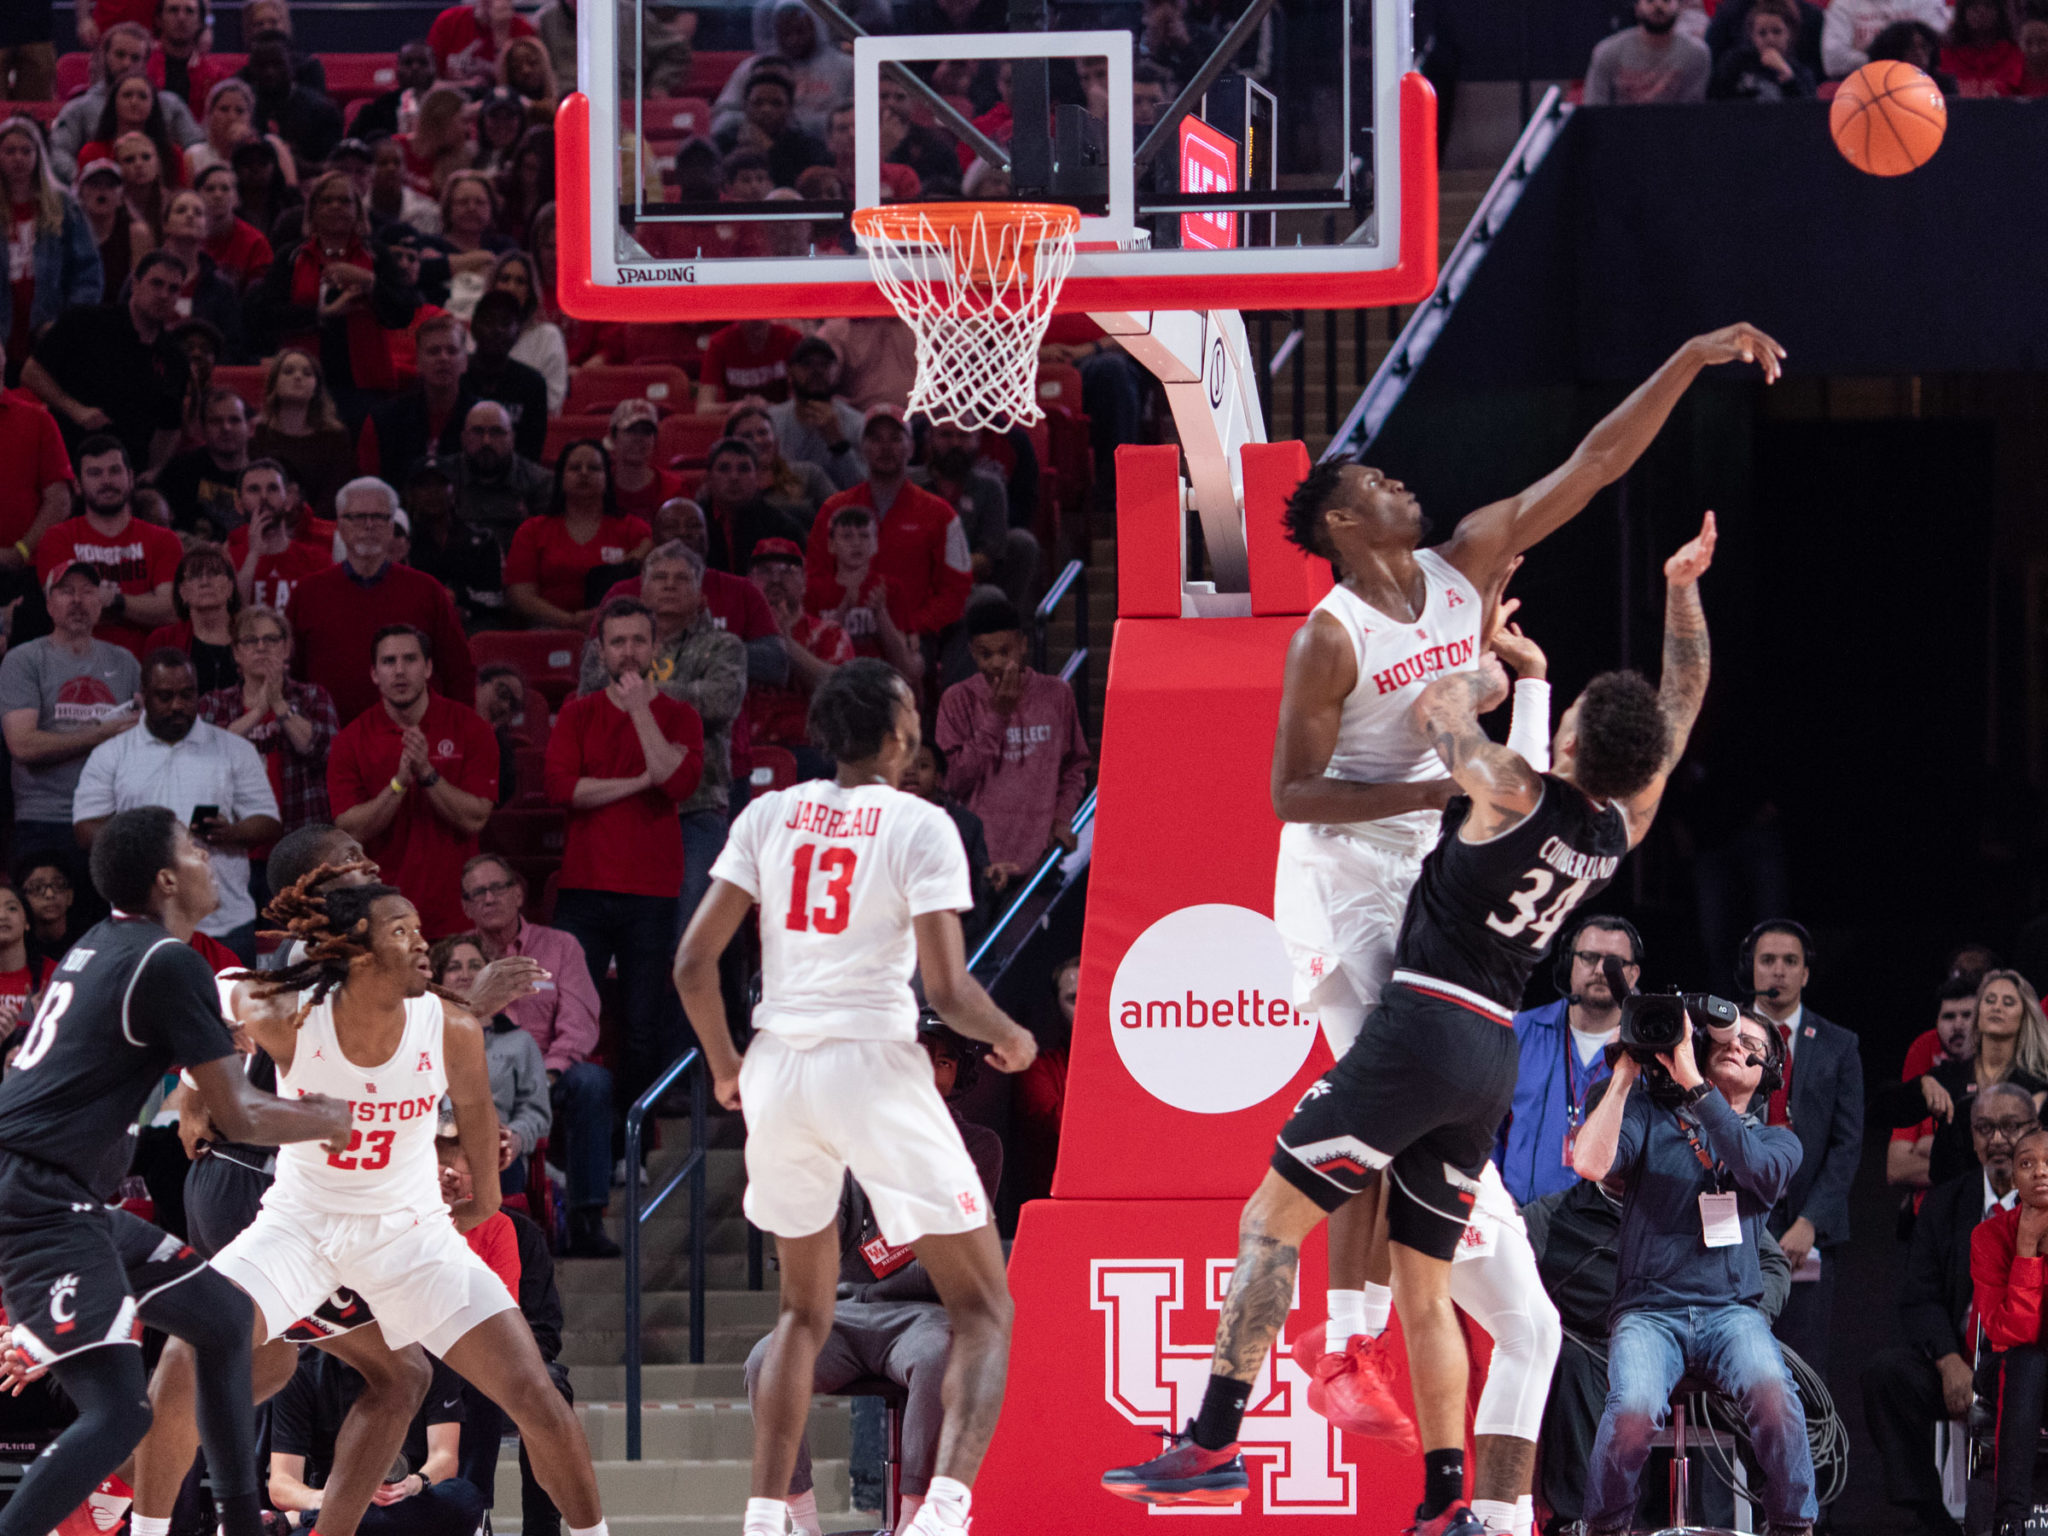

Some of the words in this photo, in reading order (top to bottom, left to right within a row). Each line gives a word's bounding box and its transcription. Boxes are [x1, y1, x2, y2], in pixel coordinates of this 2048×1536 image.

[617, 265, 696, 285] SPALDING
[1373, 634, 1474, 695] HOUSTON
[1006, 724, 1051, 744] SELECT
[785, 800, 882, 838] JARREAU
[785, 843, 858, 935] 13
[1485, 868, 1592, 949] 34
[11, 981, 74, 1071] 13
[297, 1088, 437, 1123] STON
[326, 1129, 397, 1171] 23
[1090, 1259, 1357, 1515] UH
